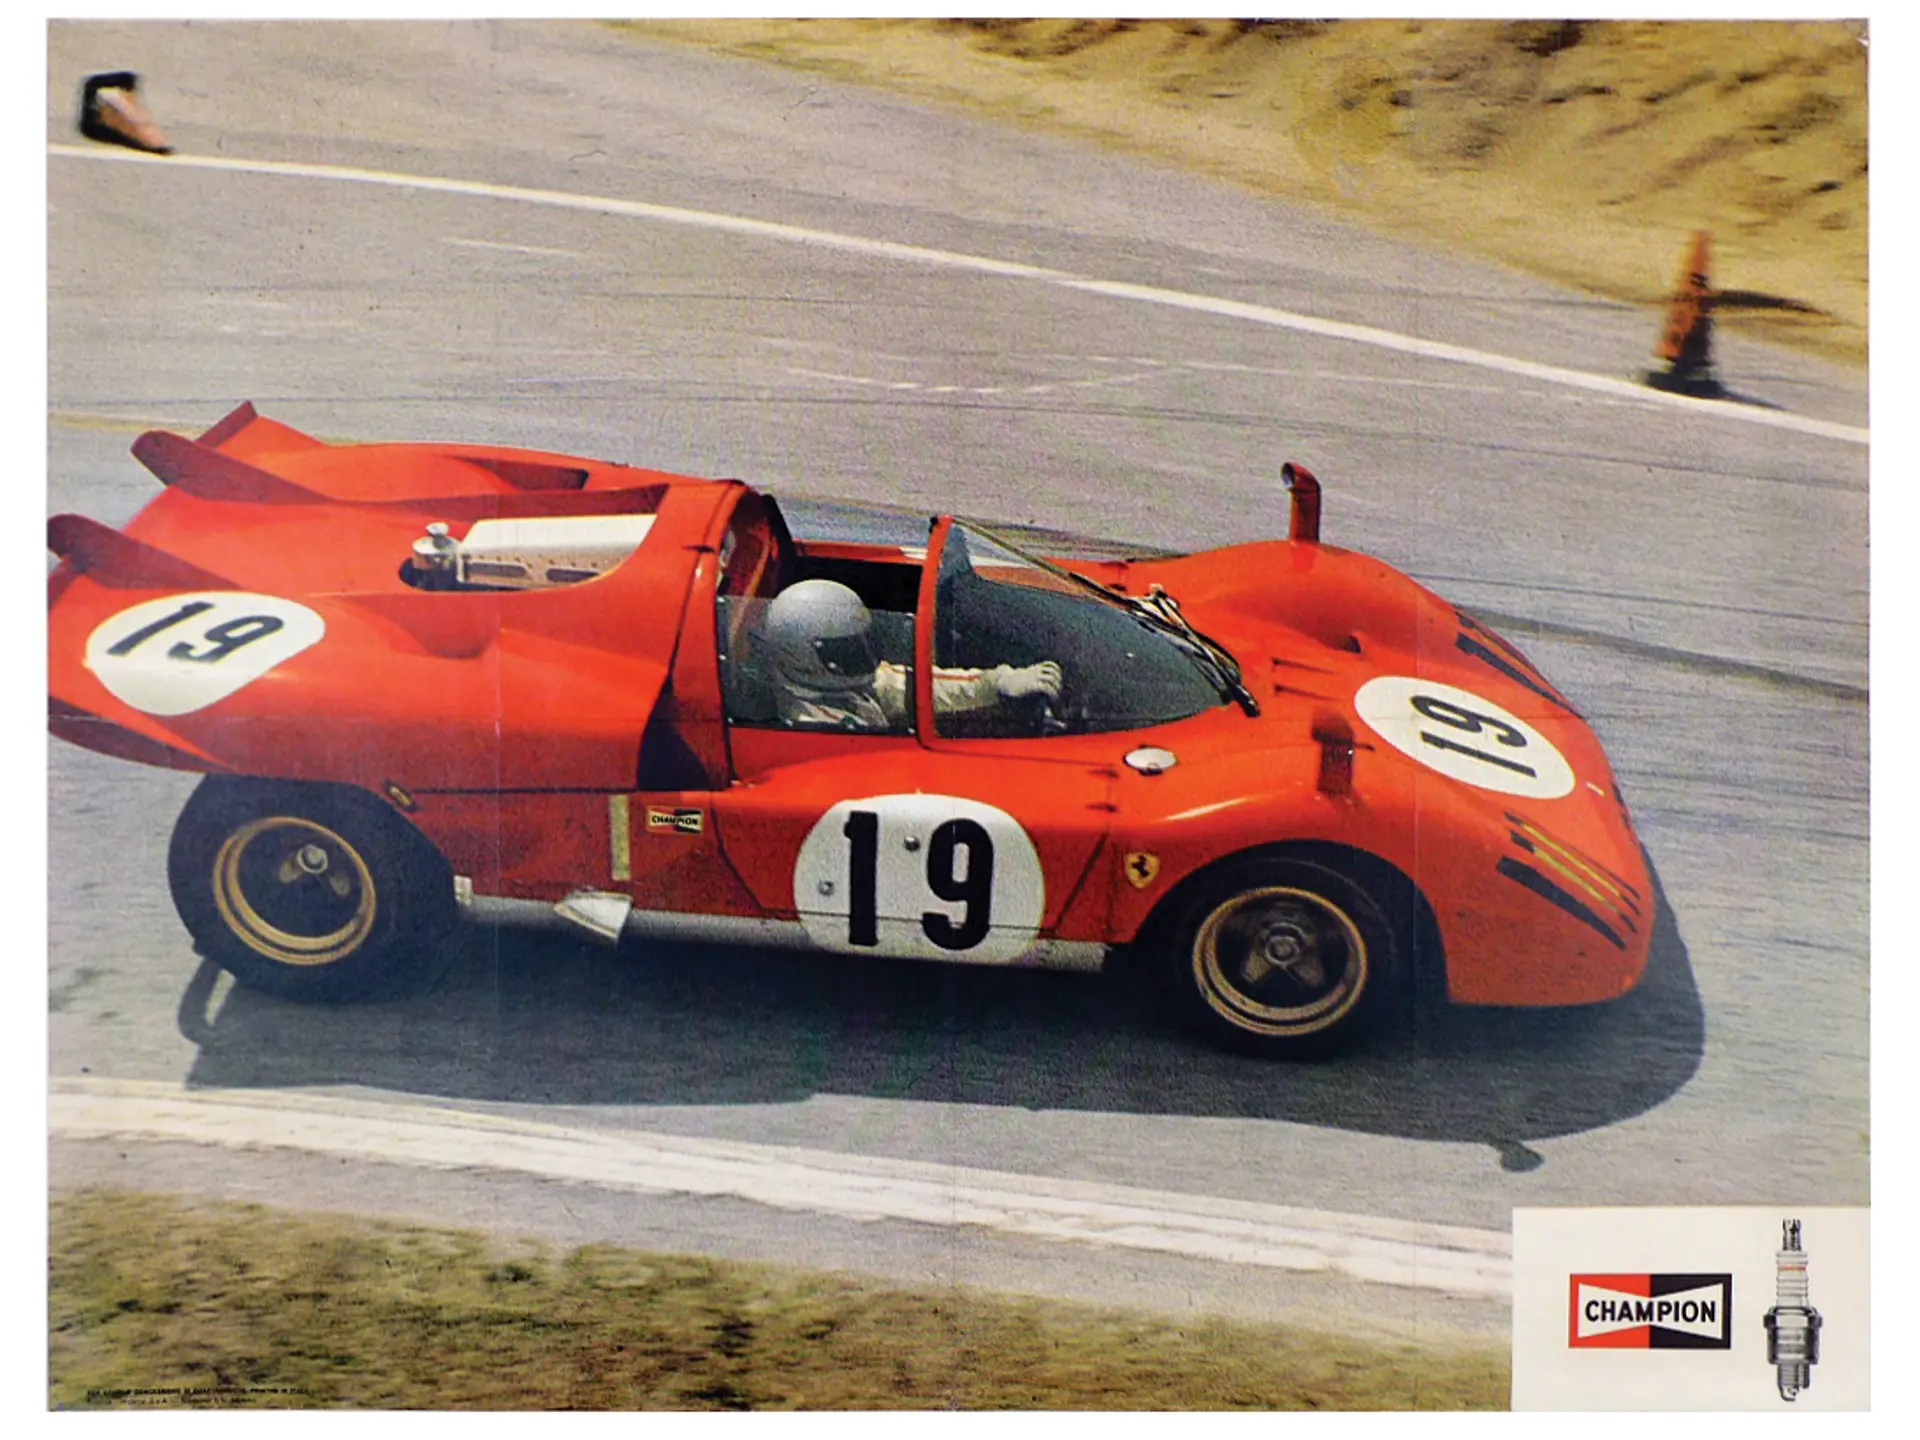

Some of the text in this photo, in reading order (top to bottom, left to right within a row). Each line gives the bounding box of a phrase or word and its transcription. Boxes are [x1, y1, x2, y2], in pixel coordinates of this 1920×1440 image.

[106, 601, 285, 664] 19
[1410, 695, 1537, 779] 19
[651, 814, 699, 826] CHAMPION
[843, 810, 994, 950] 19
[1585, 1299, 1717, 1324] CHAMPION
